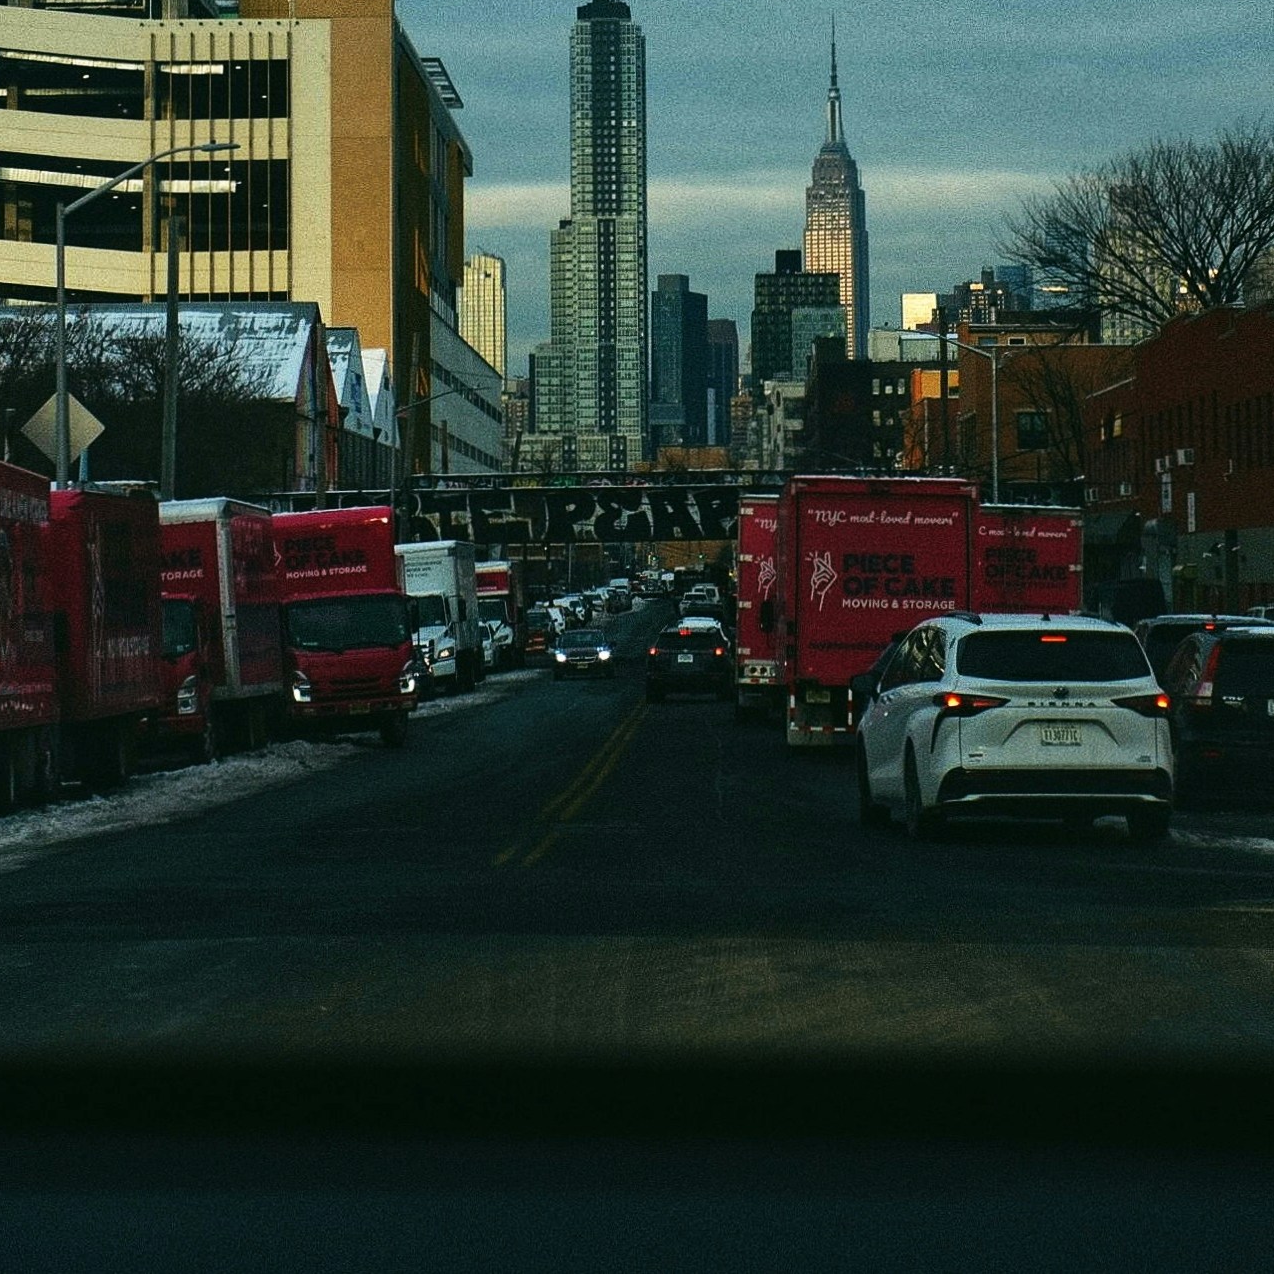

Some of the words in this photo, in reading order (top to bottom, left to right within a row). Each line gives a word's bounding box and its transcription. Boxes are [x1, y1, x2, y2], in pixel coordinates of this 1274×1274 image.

[850, 511, 911, 524] most-loved
[843, 554, 915, 574] PIECE
[286, 569, 320, 580] MOVING
[329, 565, 368, 576] STORAGE
[843, 577, 878, 596] OF
[884, 577, 956, 598] CAKE
[842, 599, 889, 610] MOVING
[891, 599, 900, 609] &
[902, 600, 955, 610] STORAGE
